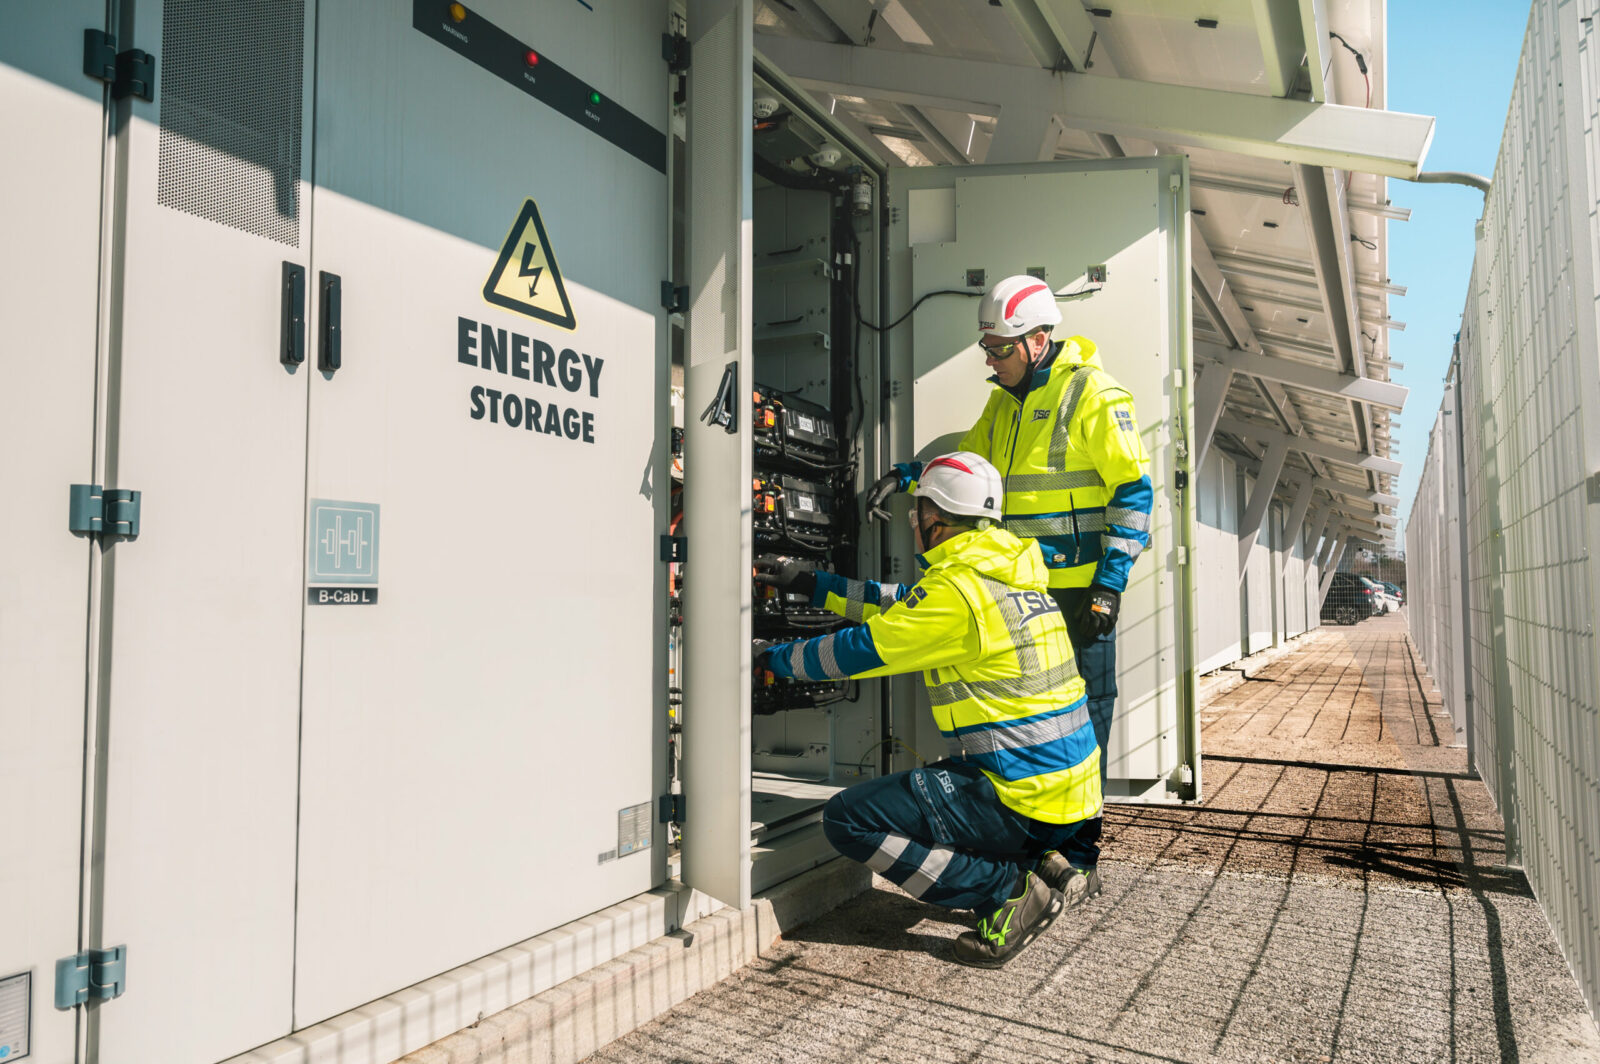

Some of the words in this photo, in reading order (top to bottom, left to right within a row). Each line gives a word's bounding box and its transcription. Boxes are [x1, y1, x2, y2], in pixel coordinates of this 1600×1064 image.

[442, 23, 468, 43] WARNING
[524, 72, 536, 84] RUN
[585, 109, 600, 122] READY
[458, 316, 604, 398] ENERGY
[470, 385, 595, 444] STORAGE
[1032, 409, 1051, 421] TSG
[319, 590, 359, 603] B-Cab
[362, 590, 370, 603] L
[936, 769, 955, 793] TSG
